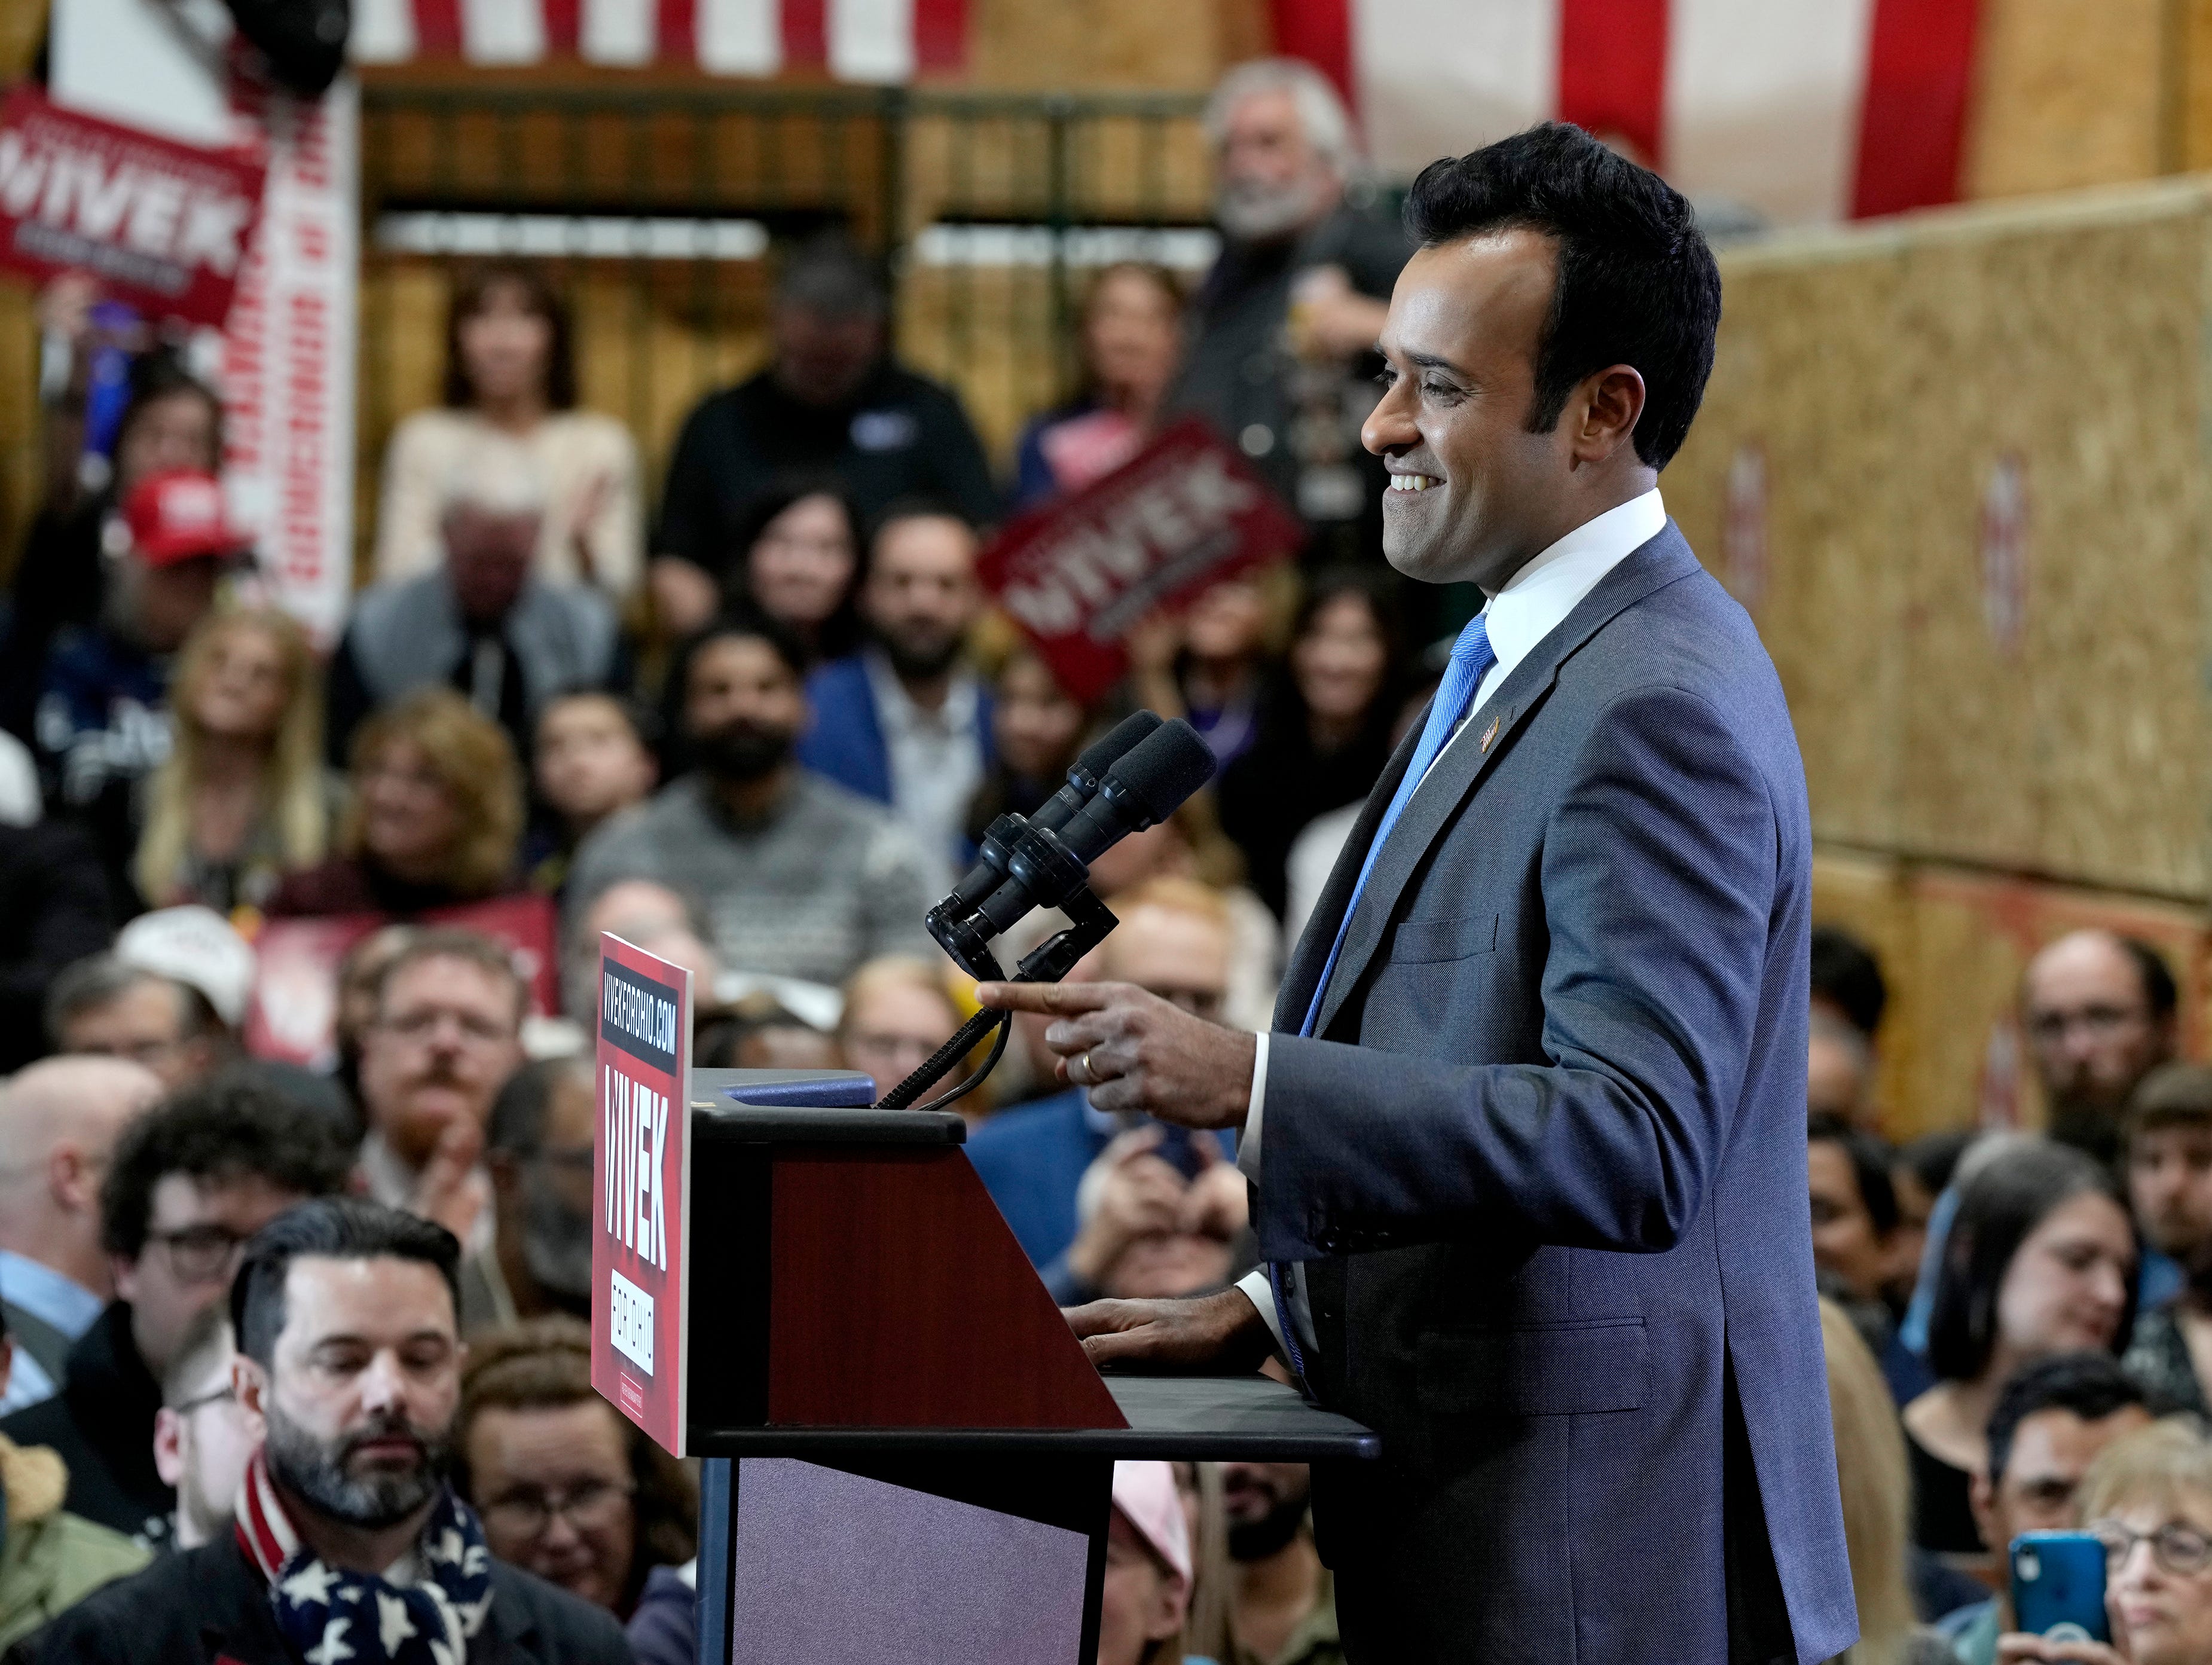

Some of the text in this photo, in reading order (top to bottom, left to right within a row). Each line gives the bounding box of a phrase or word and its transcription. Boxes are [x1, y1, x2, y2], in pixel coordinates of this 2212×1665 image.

[0, 127, 251, 279] VIVEK
[1004, 451, 1254, 635] VIVEK
[604, 971, 676, 1055] VIVEKFOROHIO.COM
[604, 1064, 668, 1272] VIVEK
[613, 1284, 652, 1359] FOR OHIO
